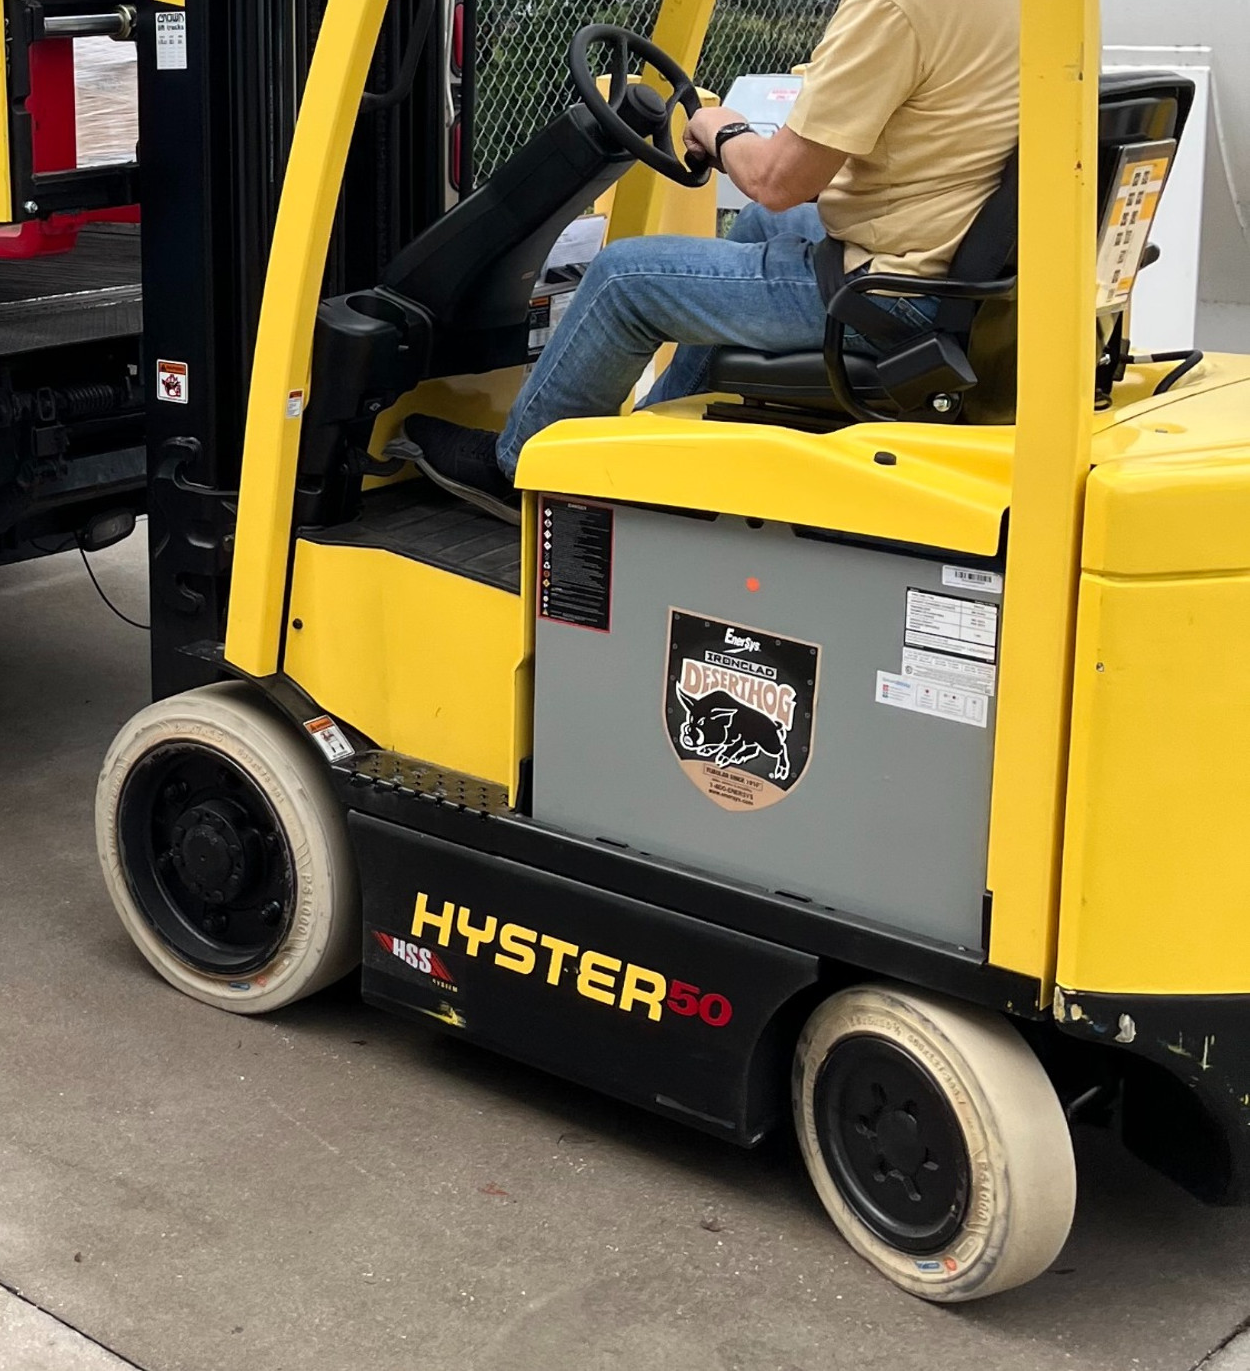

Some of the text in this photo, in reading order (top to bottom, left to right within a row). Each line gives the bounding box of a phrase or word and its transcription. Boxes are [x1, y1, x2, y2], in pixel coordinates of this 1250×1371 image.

[706, 651, 775, 677] IRONCLAD
[392, 937, 432, 974] HSS
[411, 892, 732, 1027] HYSTER 50
